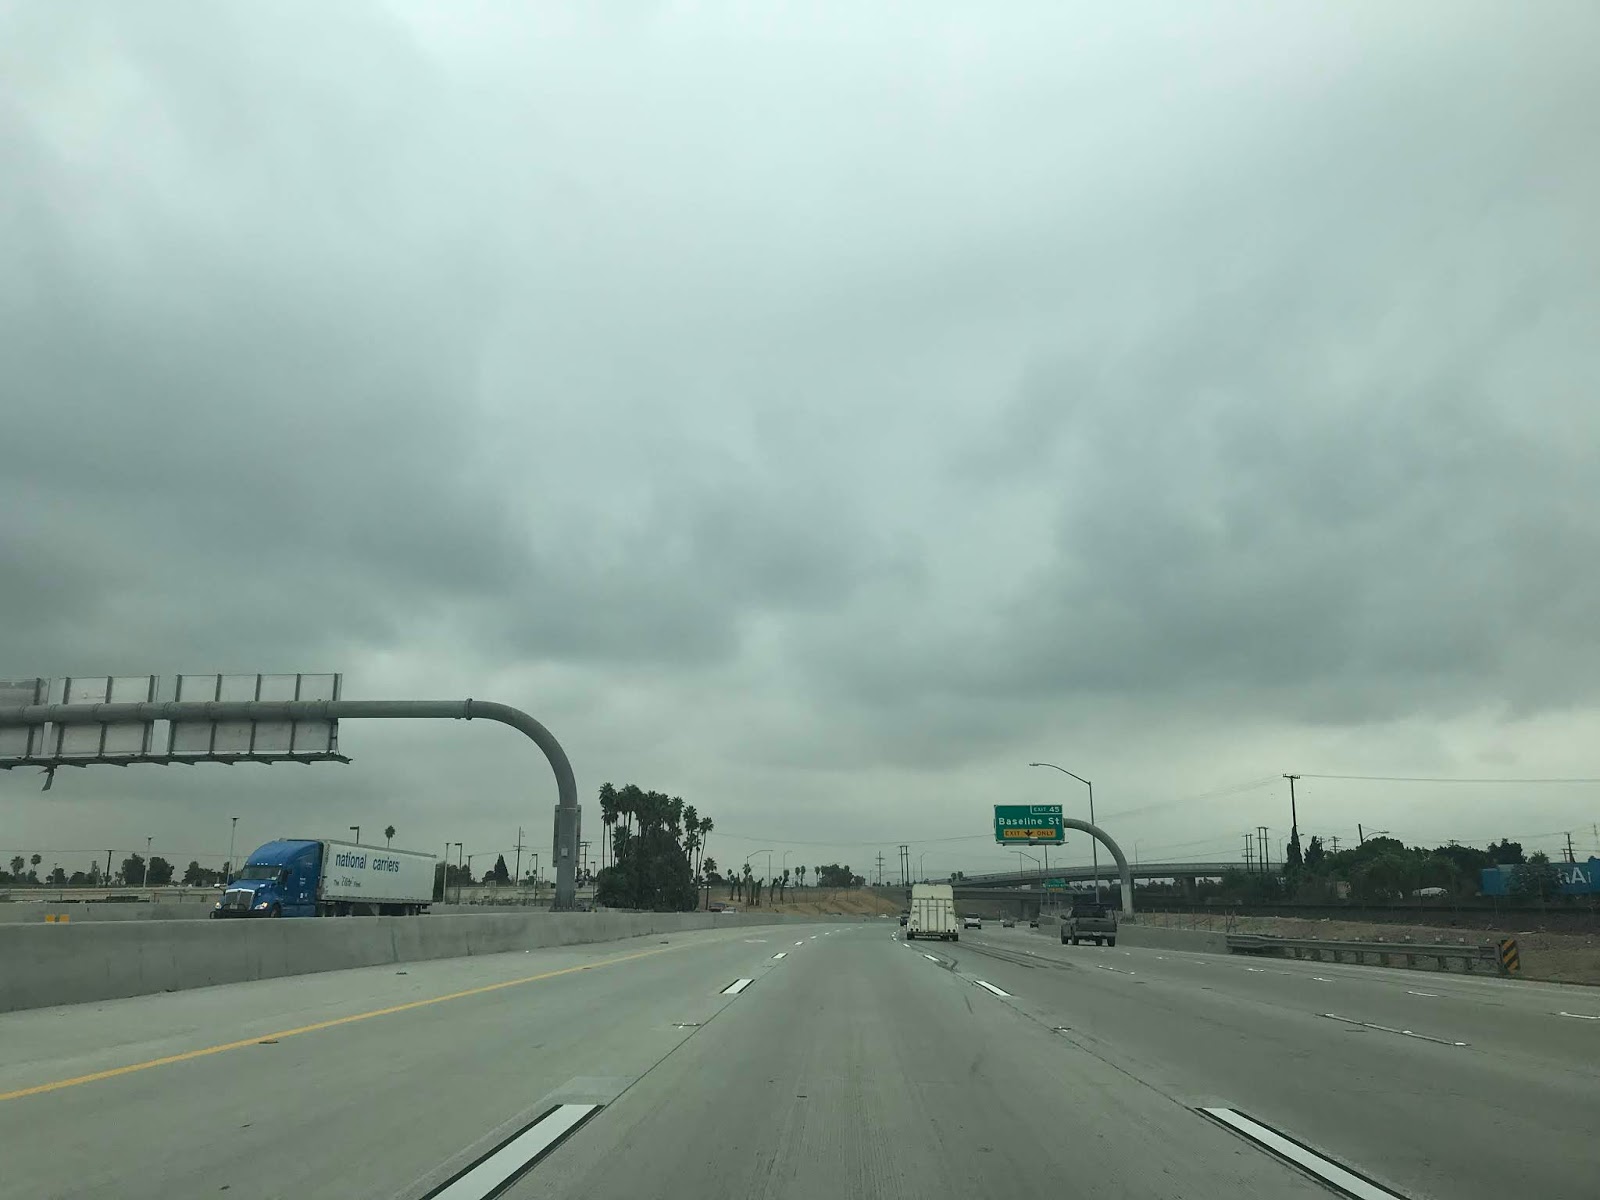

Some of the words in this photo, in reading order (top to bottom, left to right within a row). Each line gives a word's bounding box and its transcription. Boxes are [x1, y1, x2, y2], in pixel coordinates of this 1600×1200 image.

[998, 817, 1043, 825] Baseline
[1048, 817, 1060, 825] St
[335, 851, 367, 870] national
[372, 857, 399, 873] carriers
